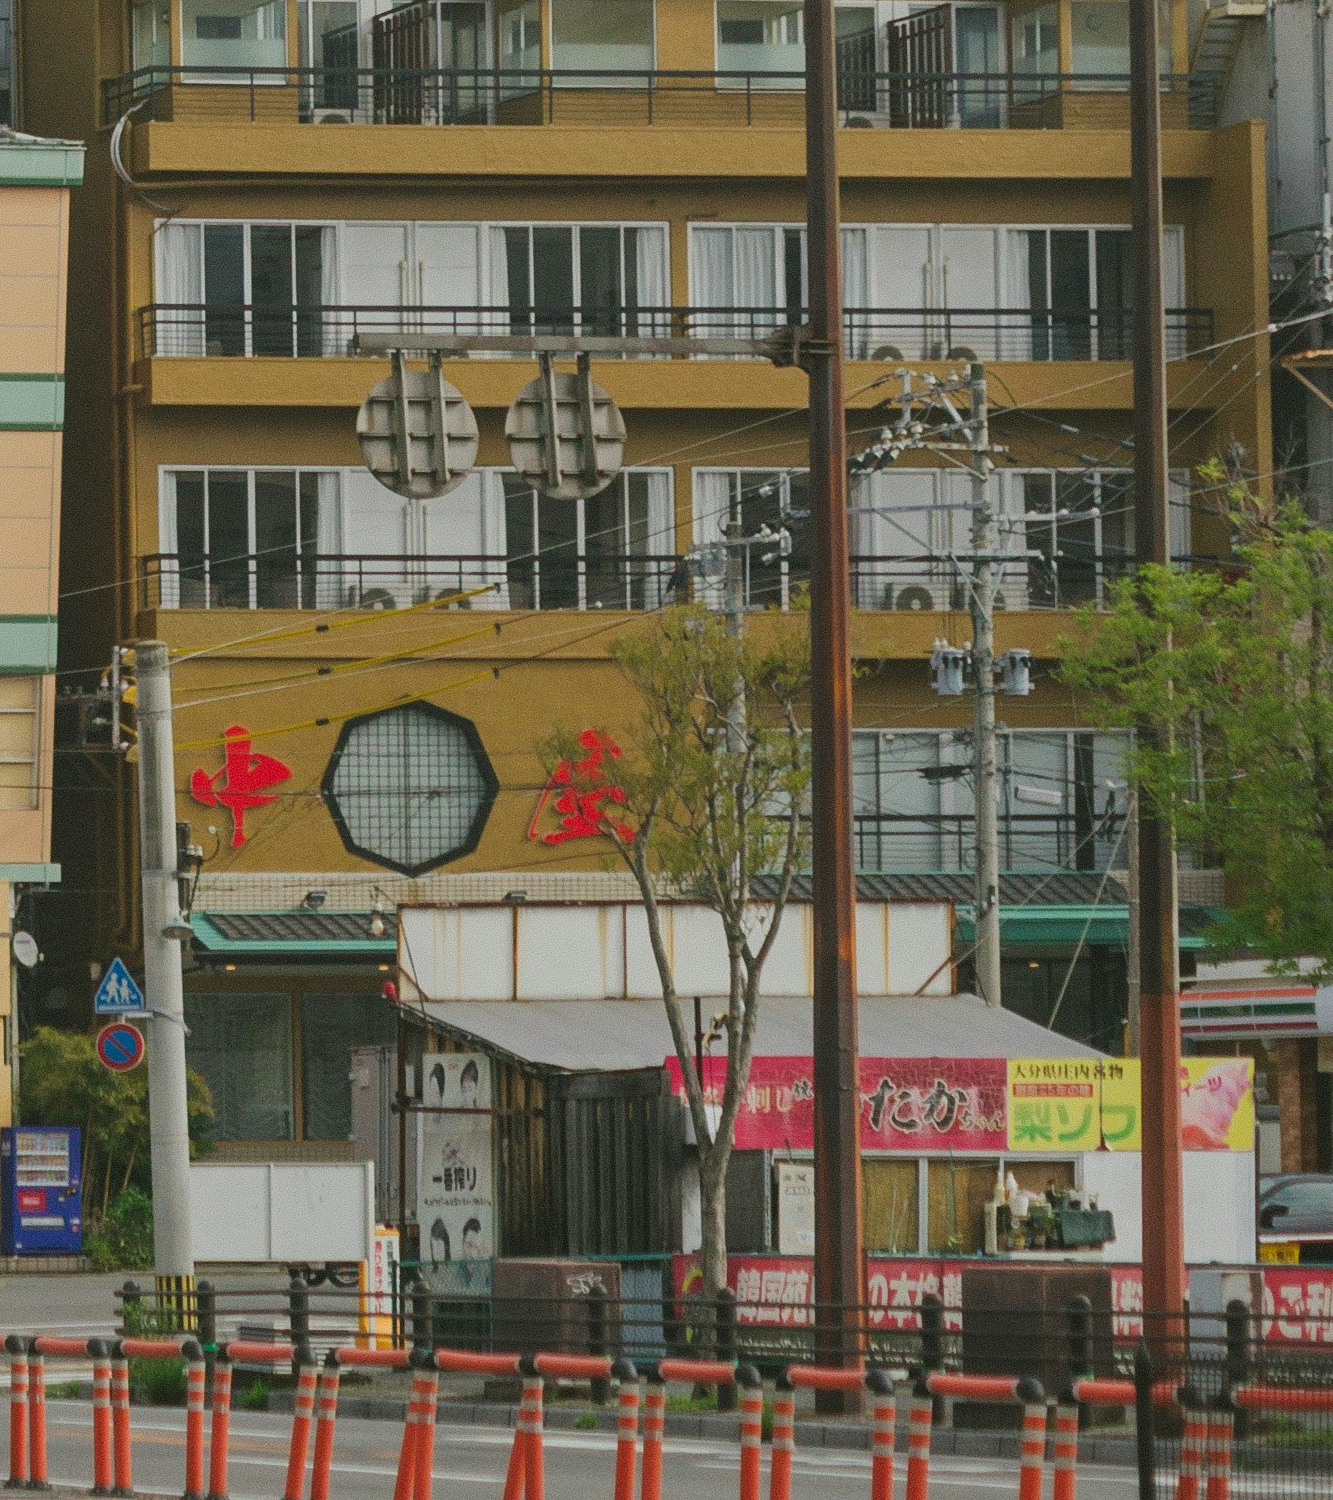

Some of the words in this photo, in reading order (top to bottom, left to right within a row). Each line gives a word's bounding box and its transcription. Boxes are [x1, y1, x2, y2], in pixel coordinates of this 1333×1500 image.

[1014, 1063, 1124, 1080] 大分県庄内名物
